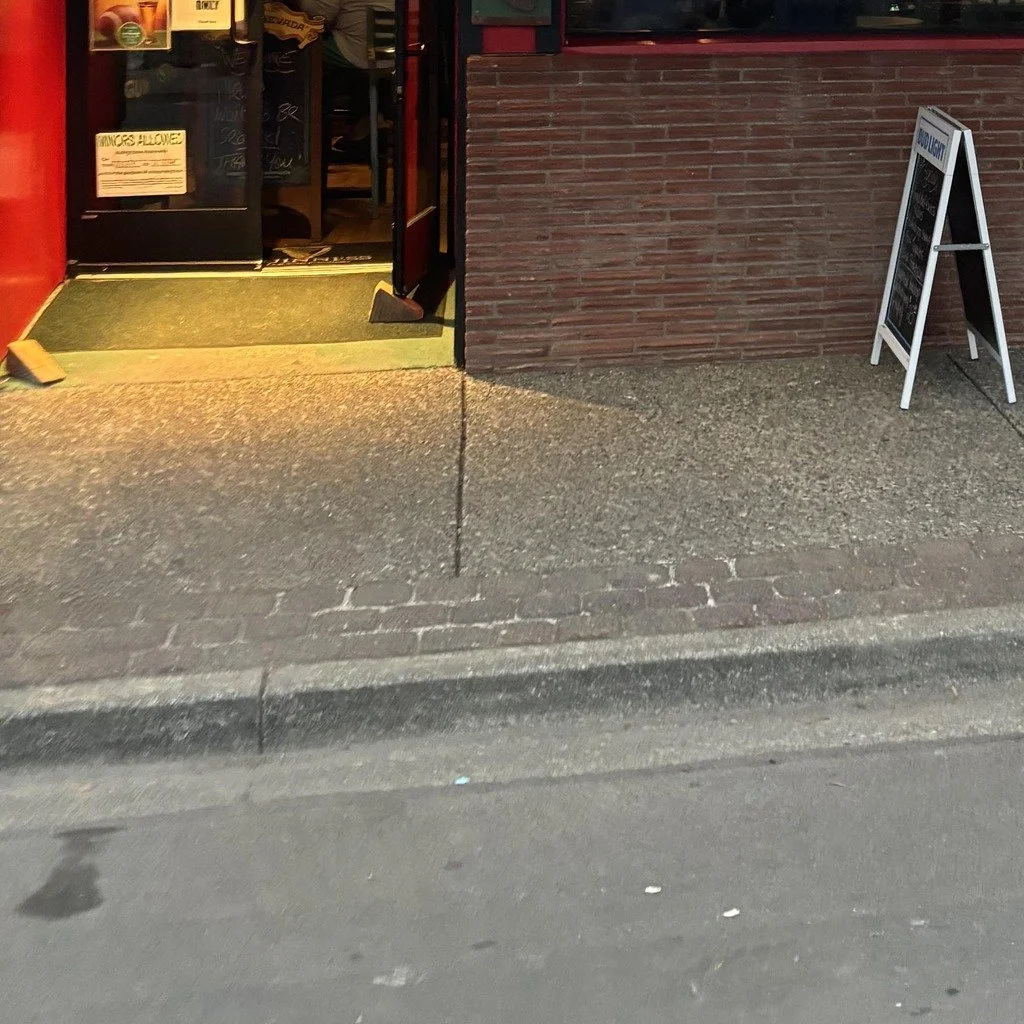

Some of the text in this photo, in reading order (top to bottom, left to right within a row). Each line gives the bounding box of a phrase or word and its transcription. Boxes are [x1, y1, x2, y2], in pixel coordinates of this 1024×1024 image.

[195, 0, 220, 11] ONLY
[267, 16, 306, 32] EVADA
[917, 128, 946, 162] BUD LIGHT
